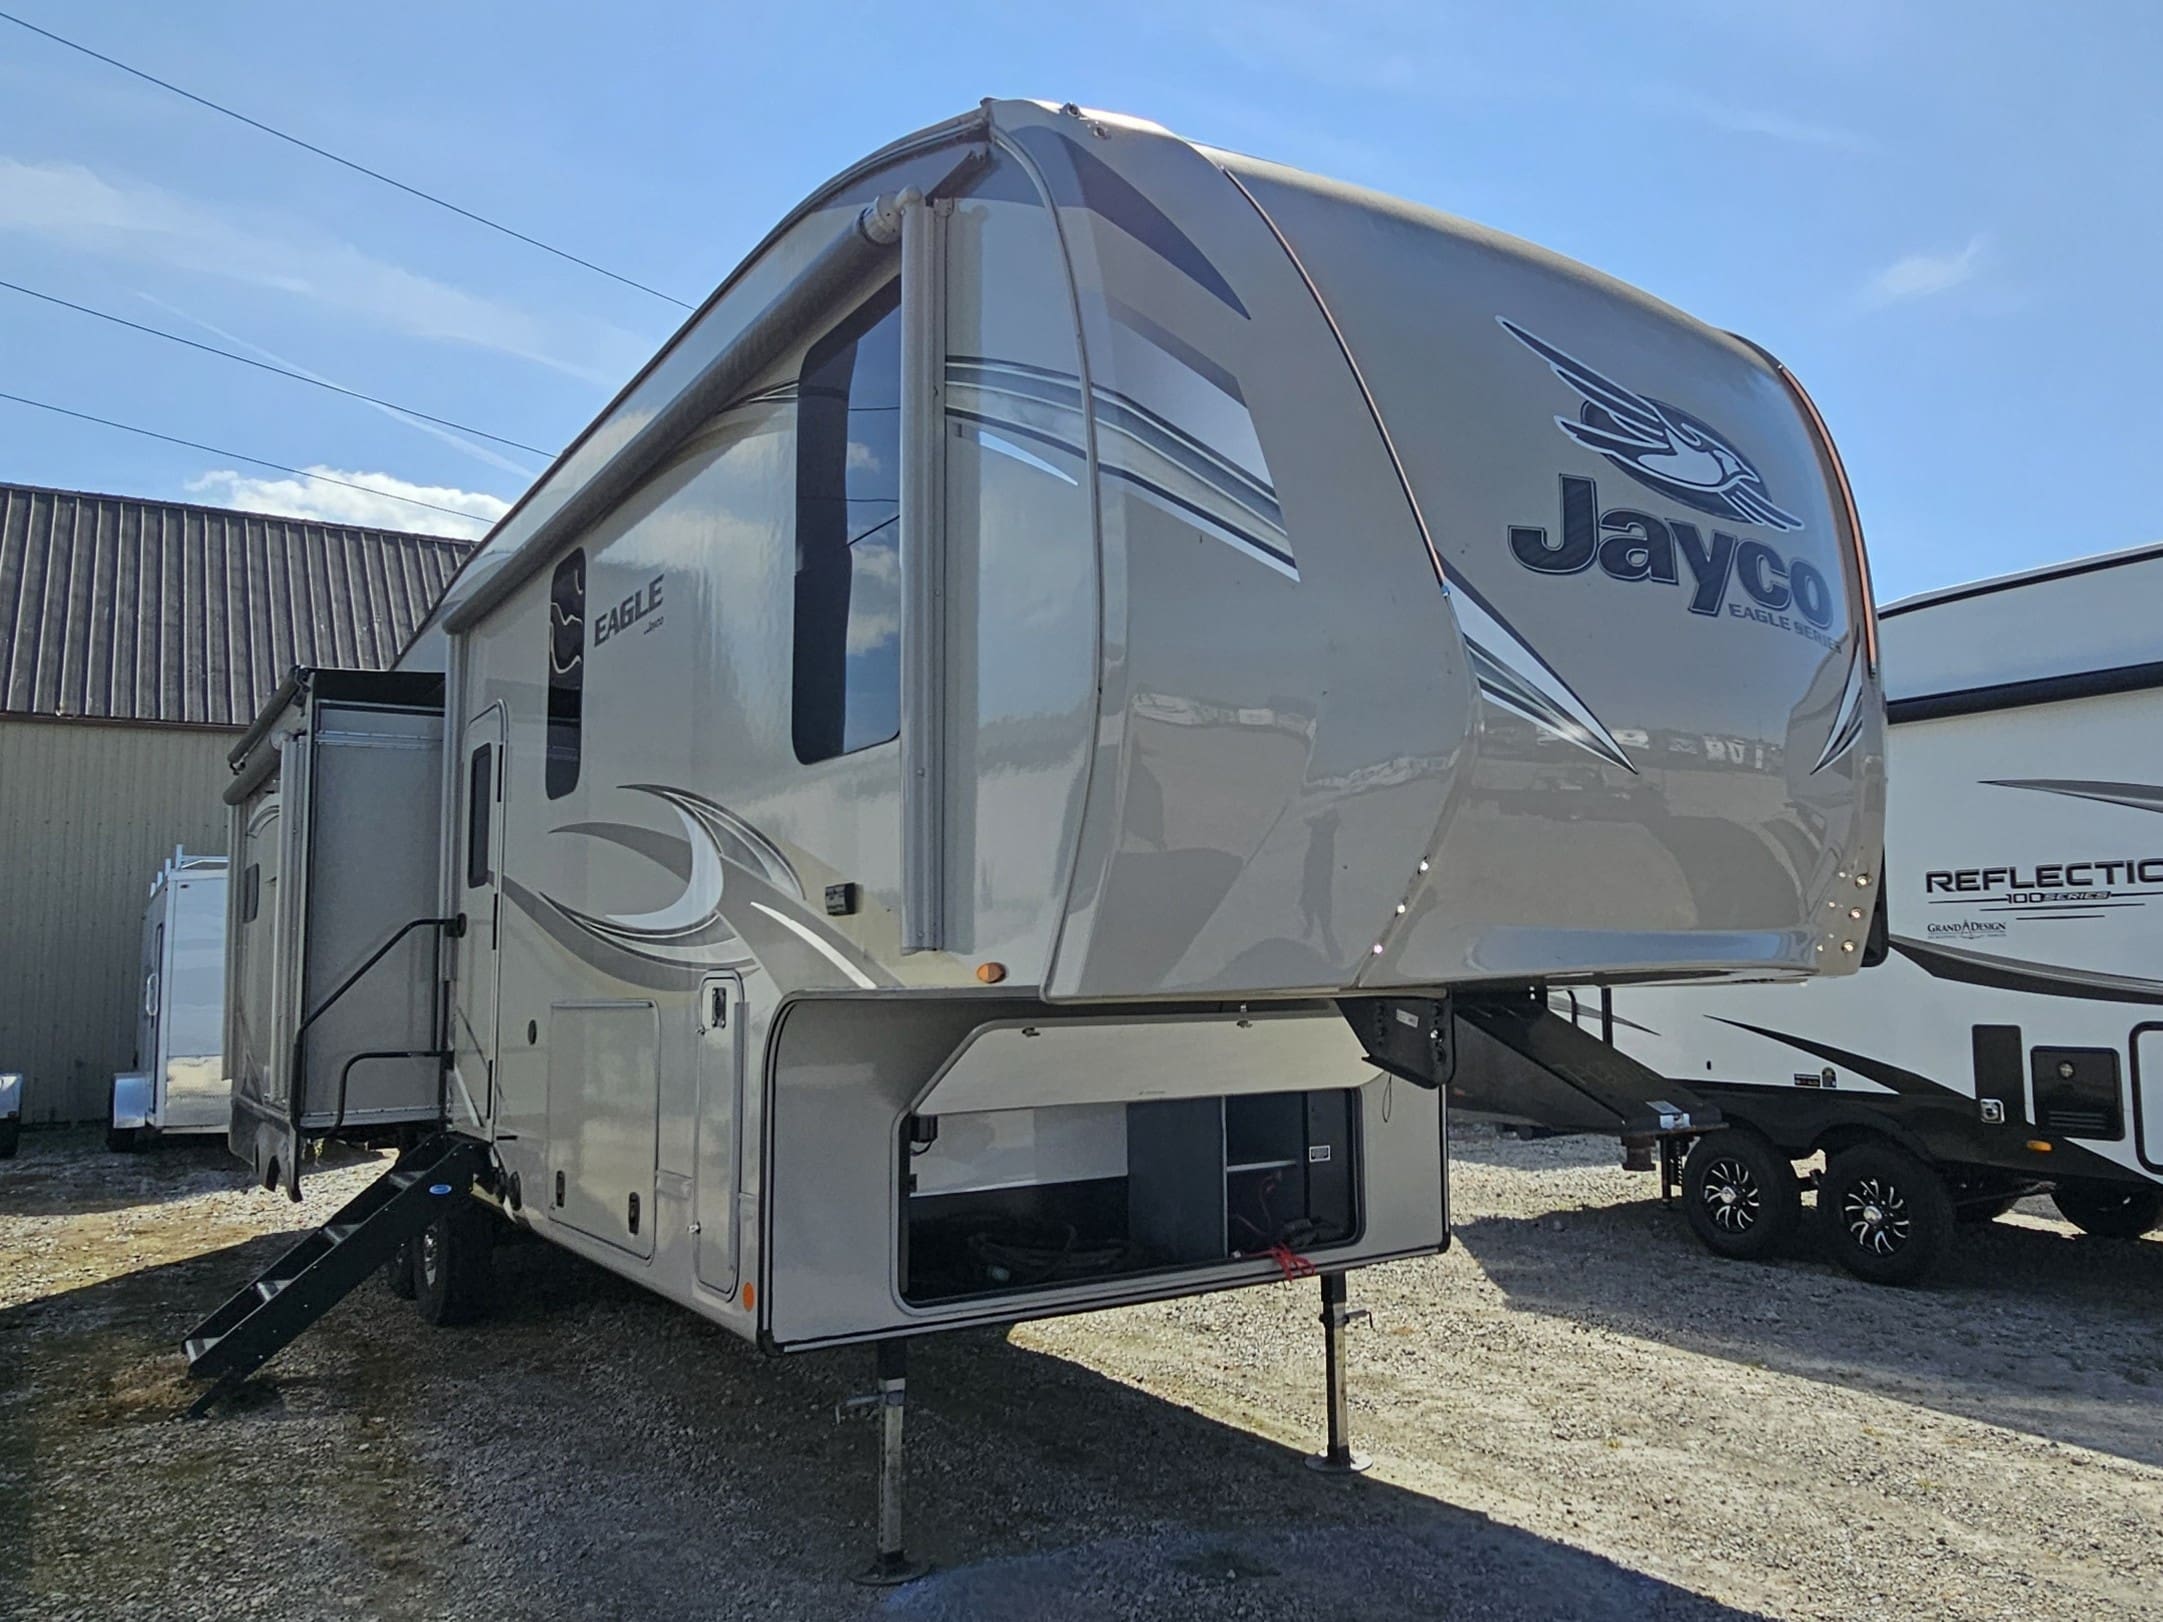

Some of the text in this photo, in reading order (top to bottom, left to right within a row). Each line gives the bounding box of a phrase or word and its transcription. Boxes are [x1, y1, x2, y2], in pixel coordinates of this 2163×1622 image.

[1507, 473, 1833, 628] Jayco
[594, 573, 665, 648] EAGLE
[1728, 603, 1791, 631] EAGLE
[2006, 892, 2045, 904] 100
[1927, 921, 2007, 933] GRAND DESIGN
